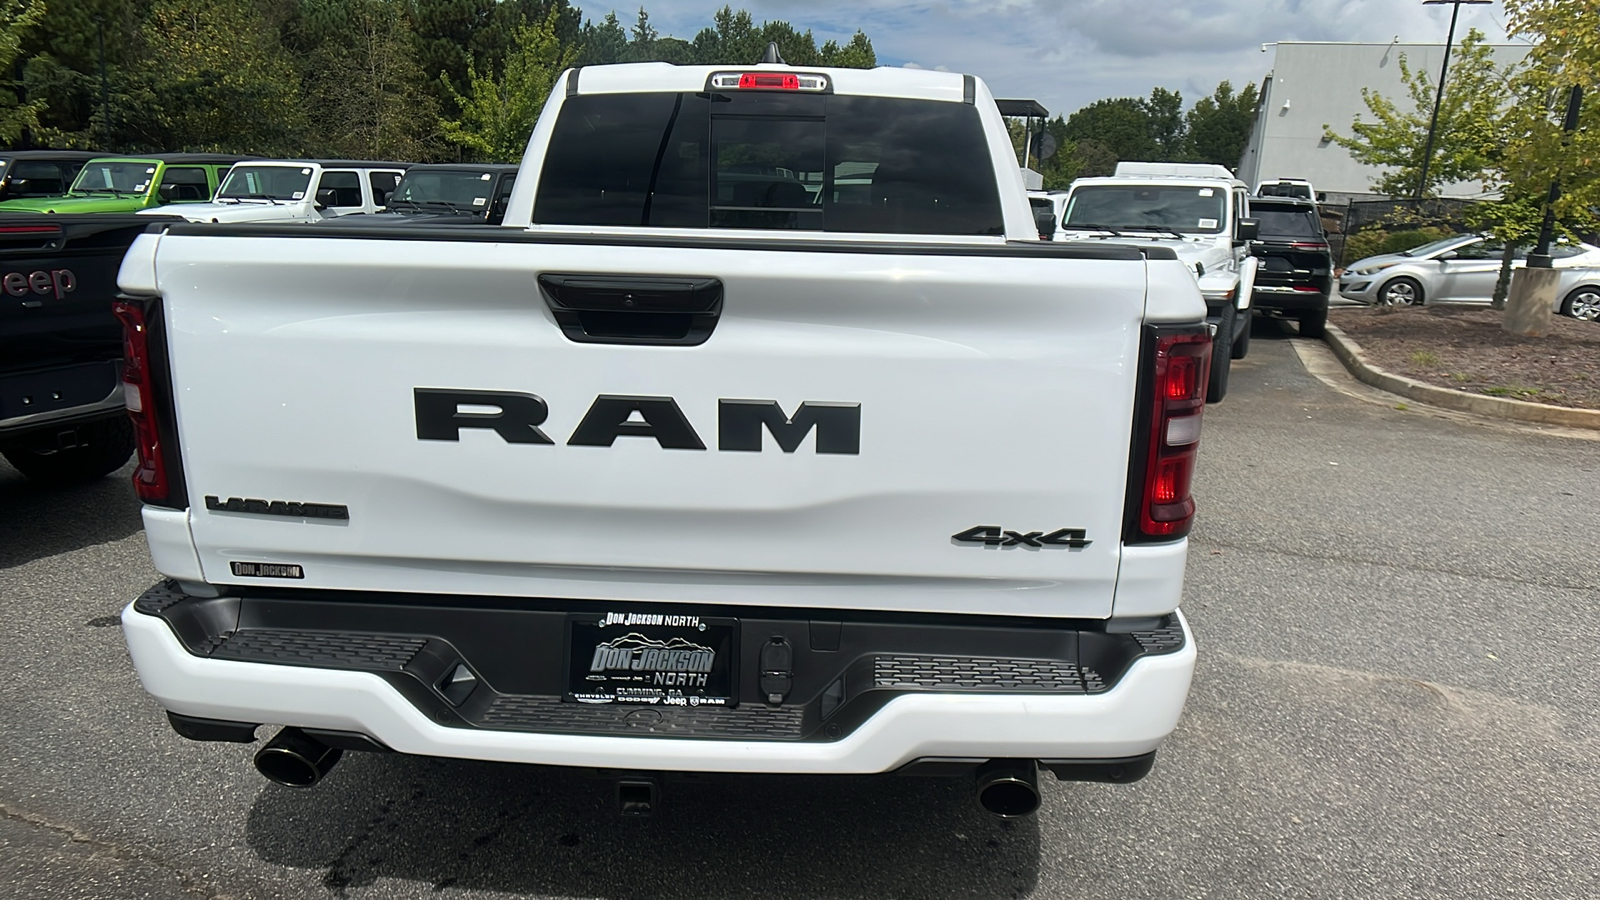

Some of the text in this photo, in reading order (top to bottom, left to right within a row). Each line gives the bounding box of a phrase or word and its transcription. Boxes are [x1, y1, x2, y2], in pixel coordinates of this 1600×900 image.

[0, 269, 77, 301] eep
[413, 386, 861, 455] RAM
[205, 495, 350, 520] LARAMIE
[951, 525, 1094, 548] 4x4
[234, 562, 300, 577] DON JACKSON
[606, 612, 699, 627] DON JACKSON NORTH
[590, 646, 716, 673] DON JACKSON
[653, 672, 708, 687] NORTH
[663, 696, 688, 706] Jeep
